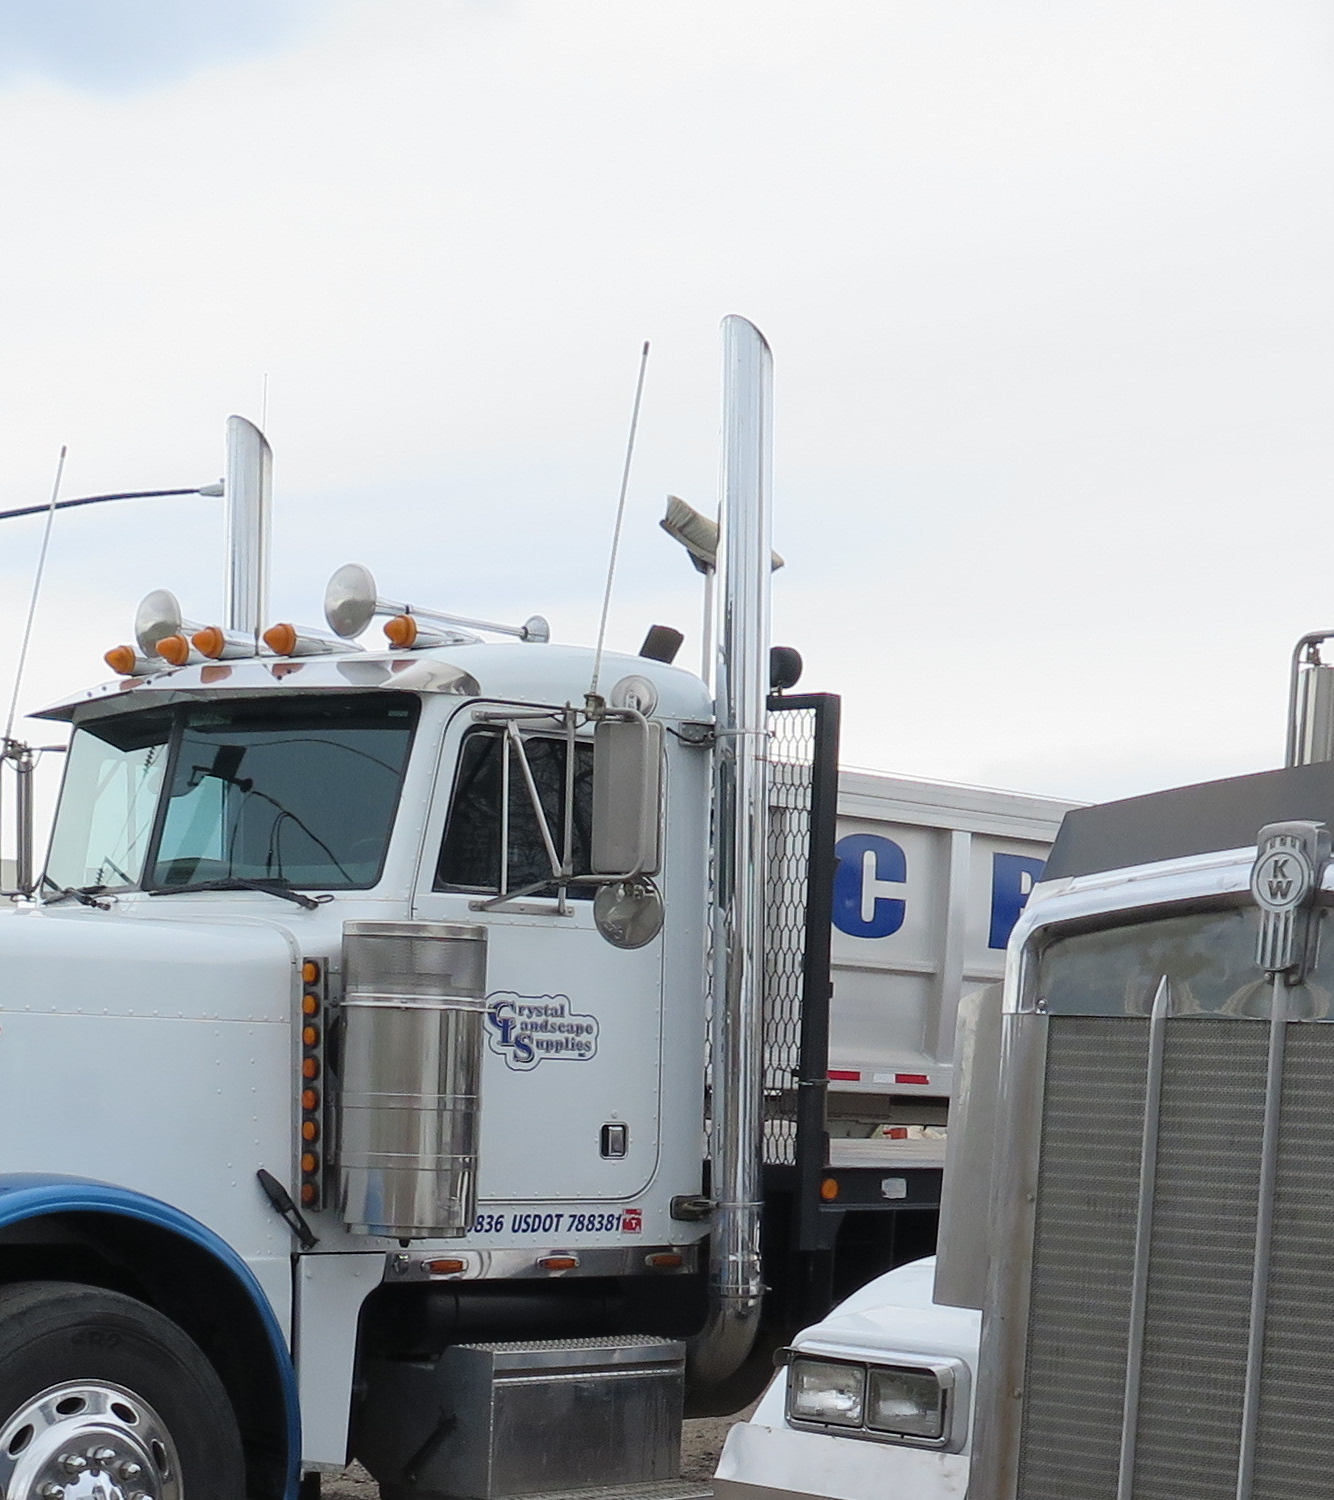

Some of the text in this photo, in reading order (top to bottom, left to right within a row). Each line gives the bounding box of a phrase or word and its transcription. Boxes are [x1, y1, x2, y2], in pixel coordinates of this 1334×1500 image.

[487, 1000, 566, 1029] Crystal
[497, 1016, 594, 1047] Landscape
[513, 1031, 593, 1063] Supplies
[511, 1214, 565, 1233] USDOT
[566, 1213, 622, 1233] 788381
